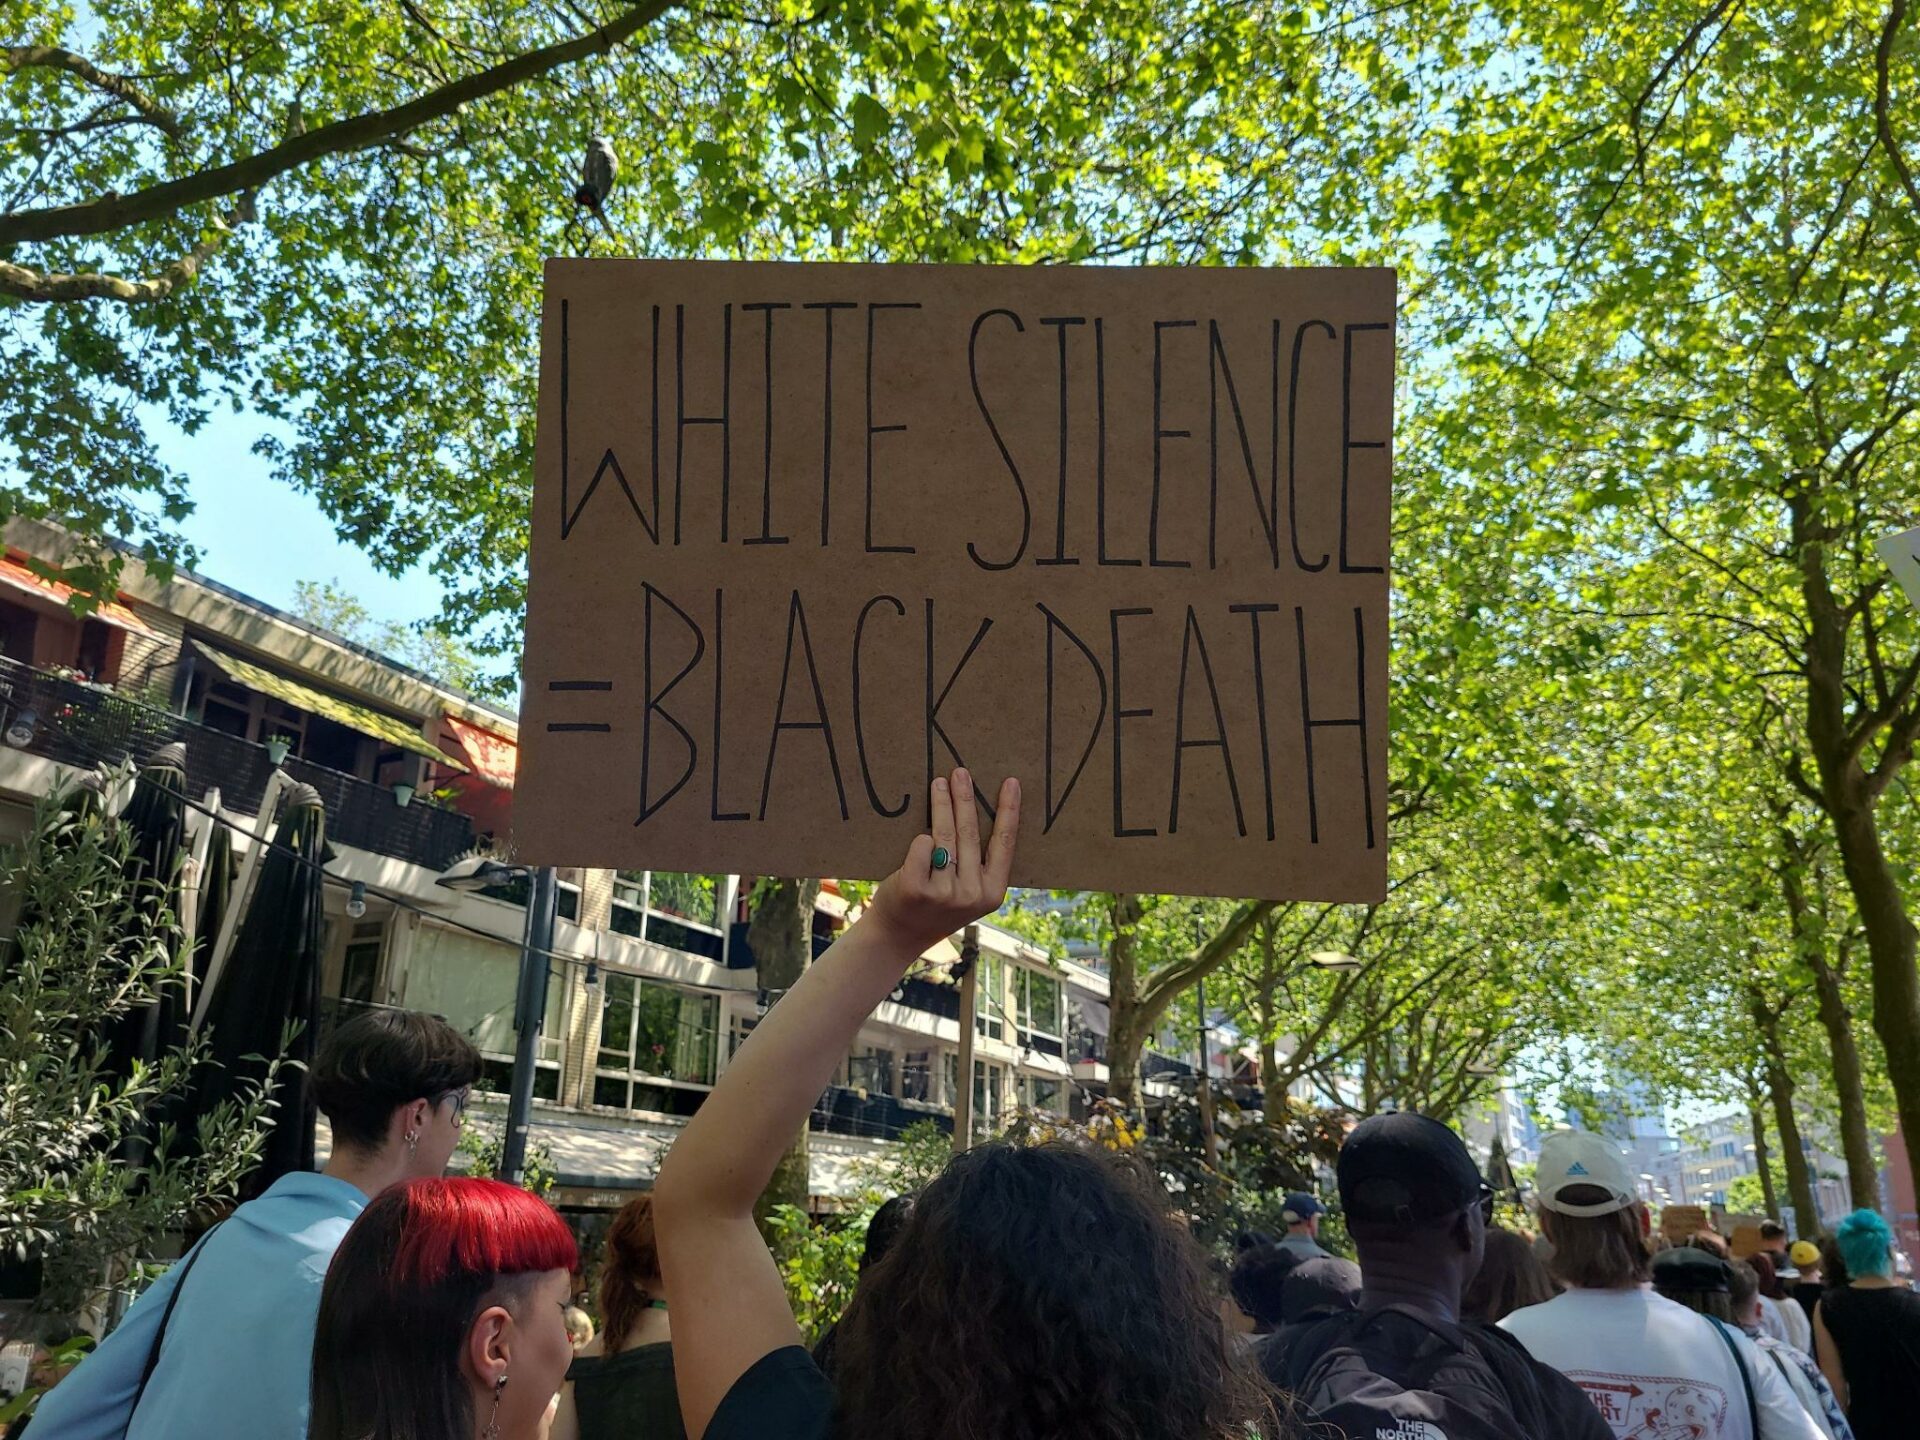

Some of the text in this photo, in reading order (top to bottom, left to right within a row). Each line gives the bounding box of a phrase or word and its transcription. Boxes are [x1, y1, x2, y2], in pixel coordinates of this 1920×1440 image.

[561, 299, 1389, 574] WHITE SILENCE
[634, 581, 997, 829] BLACK
[1036, 602, 1376, 849] DEATH
[1588, 1391, 1613, 1407] HE
[1375, 1427, 1424, 1440] NORTH
[1395, 1418, 1424, 1433] THE
